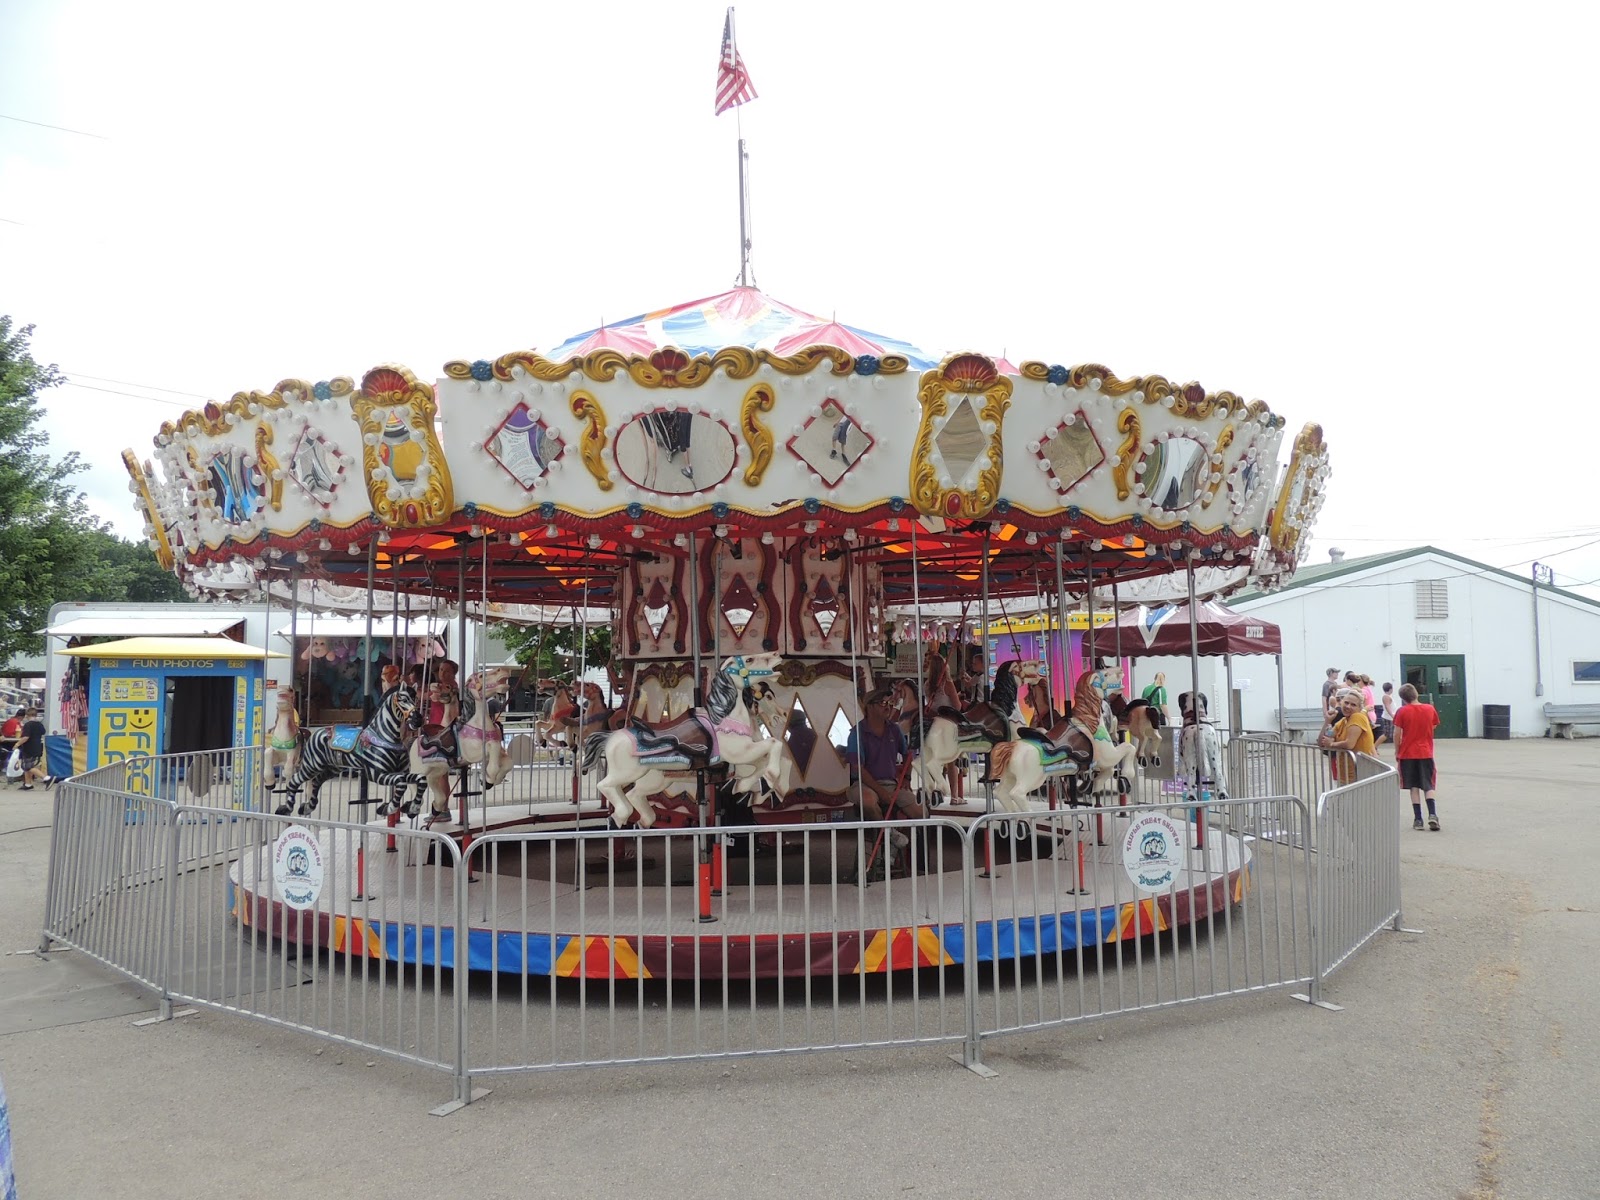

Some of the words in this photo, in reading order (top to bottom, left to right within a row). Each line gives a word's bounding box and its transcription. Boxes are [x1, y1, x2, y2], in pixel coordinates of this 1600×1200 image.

[132, 659, 158, 668] FUN
[163, 659, 214, 668] PHOTOS
[276, 837, 288, 864] TRIPLE
[288, 832, 306, 840] TREAT
[1126, 824, 1141, 852] TRIPLE
[1141, 817, 1161, 826] TREAT
